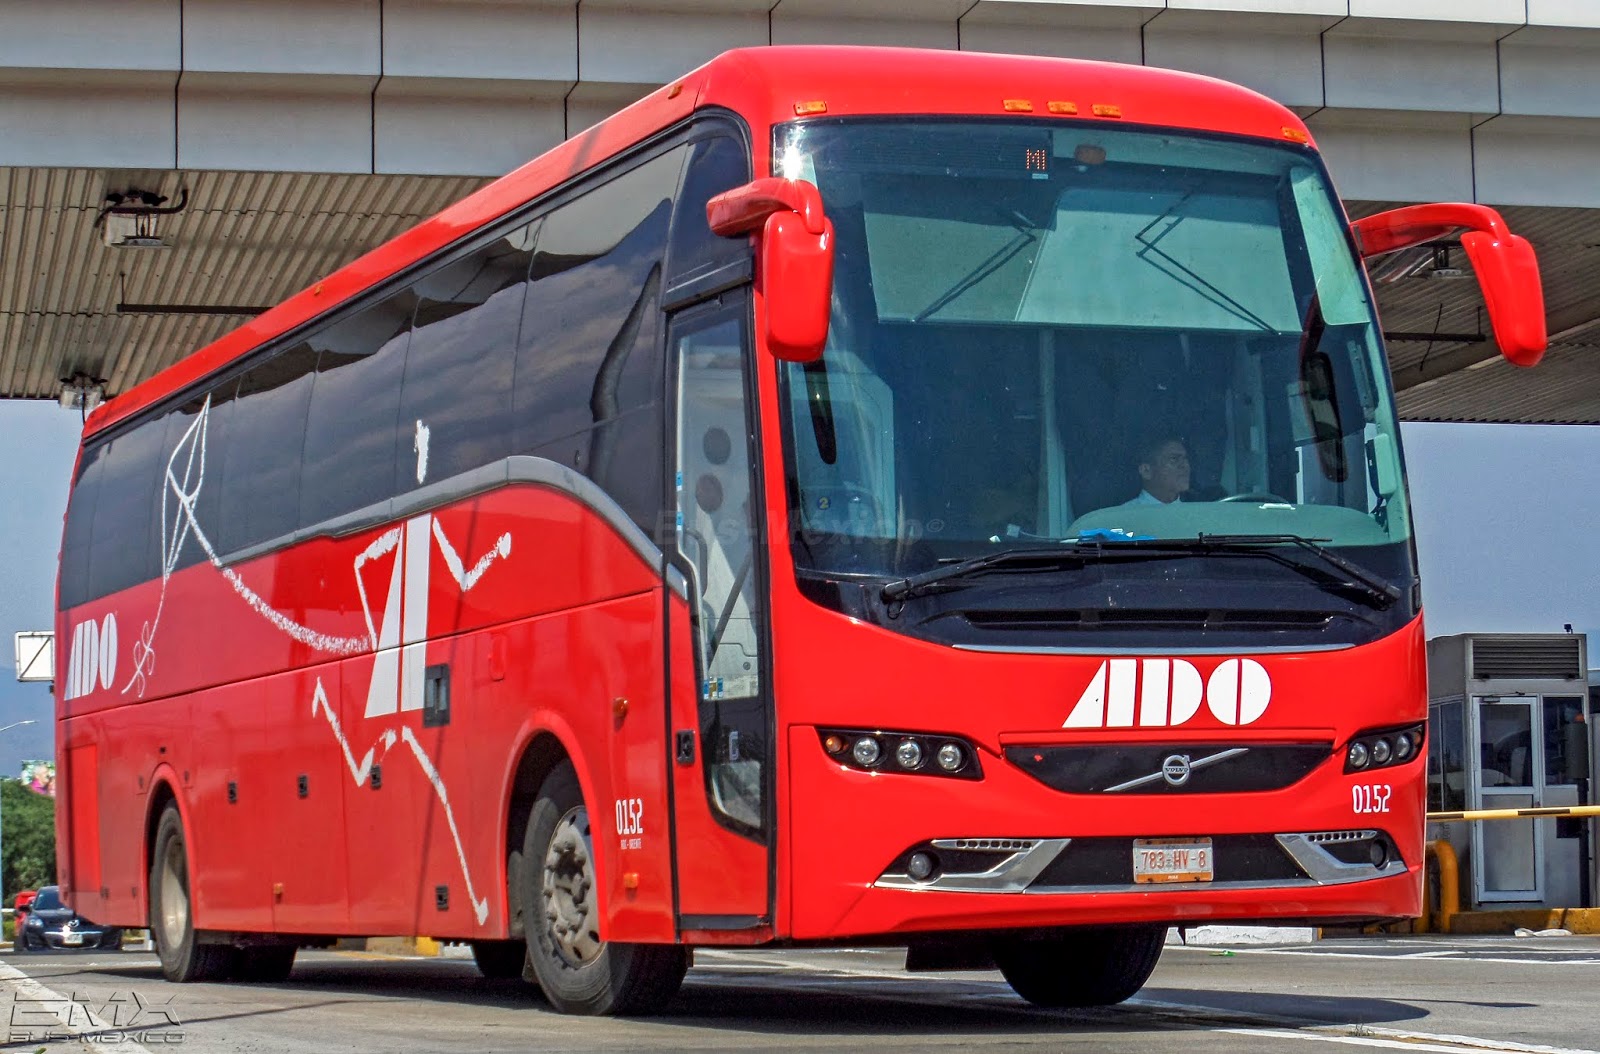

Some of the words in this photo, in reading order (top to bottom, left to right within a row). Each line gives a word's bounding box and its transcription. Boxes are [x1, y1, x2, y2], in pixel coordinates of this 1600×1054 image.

[63, 612, 118, 701] ADO
[1061, 658, 1272, 728] ADO
[615, 797, 644, 835] 0152
[1352, 784, 1392, 814] 0152
